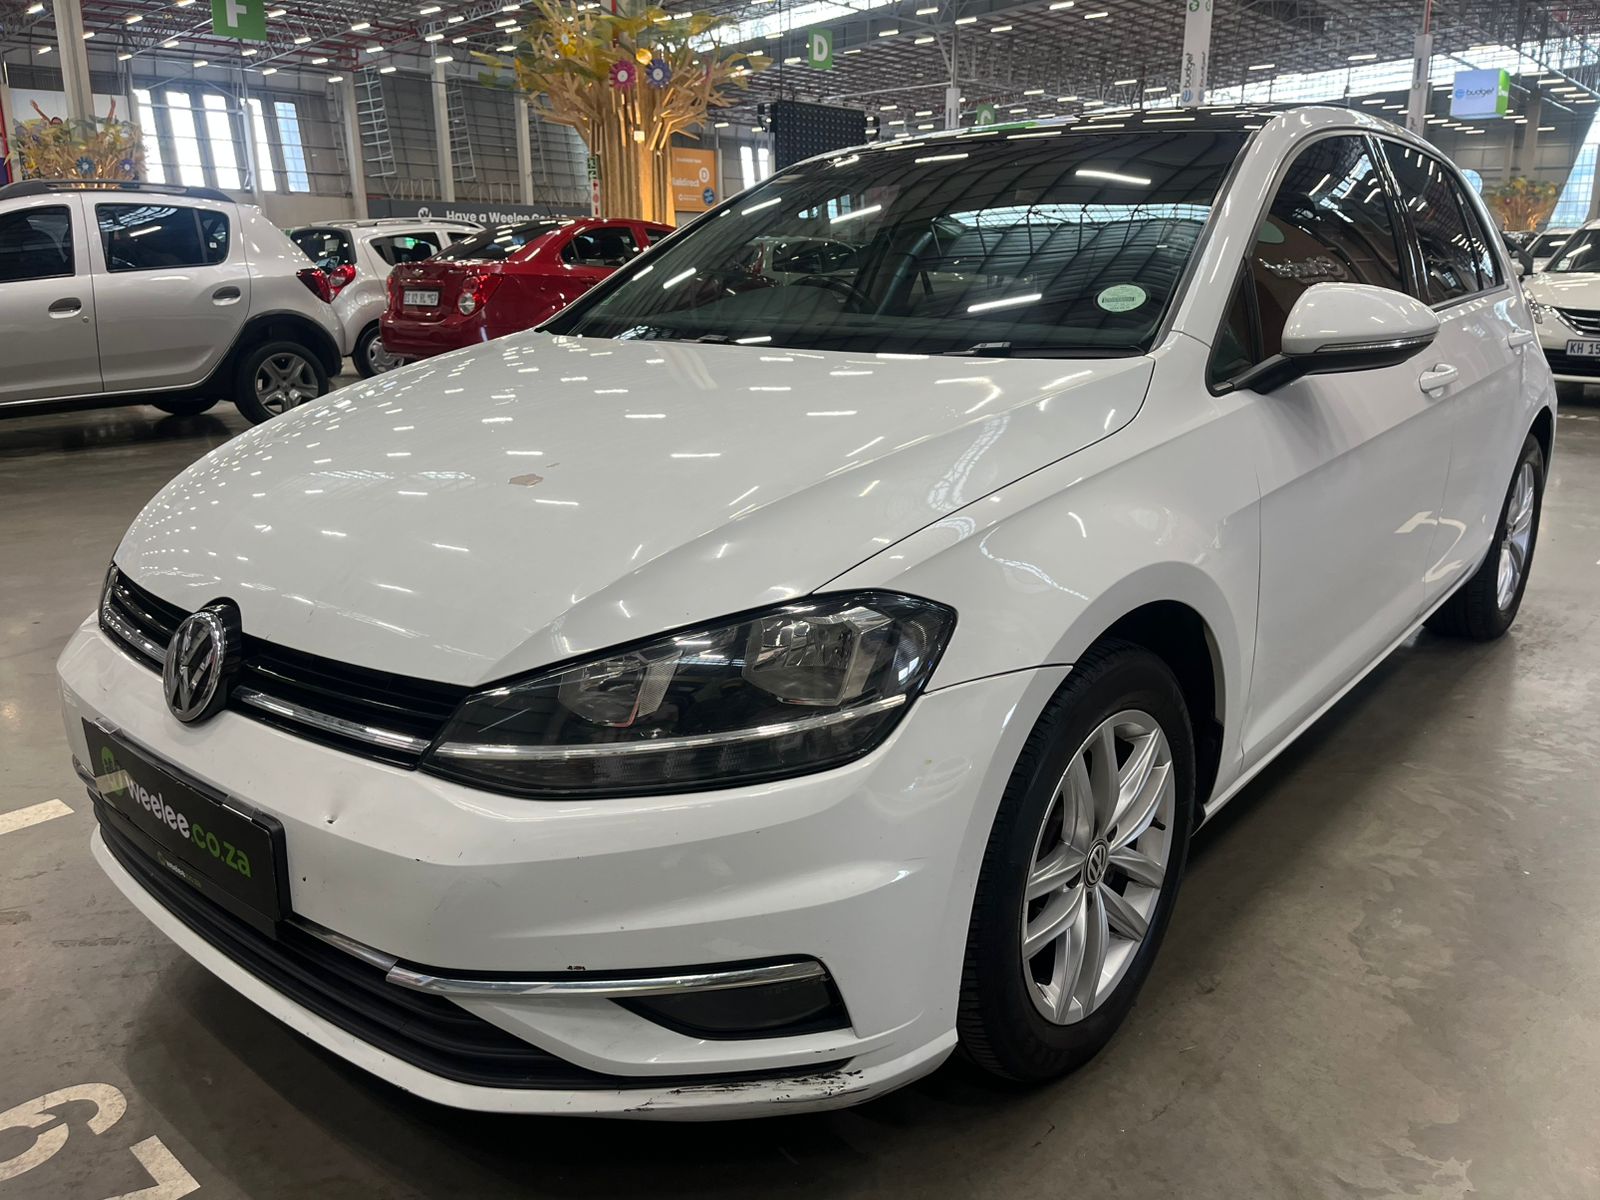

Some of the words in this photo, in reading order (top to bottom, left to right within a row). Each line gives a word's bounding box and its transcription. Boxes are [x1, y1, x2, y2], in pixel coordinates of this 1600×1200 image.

[812, 33, 829, 62] D
[1465, 87, 1495, 98] budget
[446, 210, 477, 222] Have
[479, 213, 487, 223] a
[1570, 342, 1585, 354] KH
[124, 774, 252, 879] weelee.co.za
